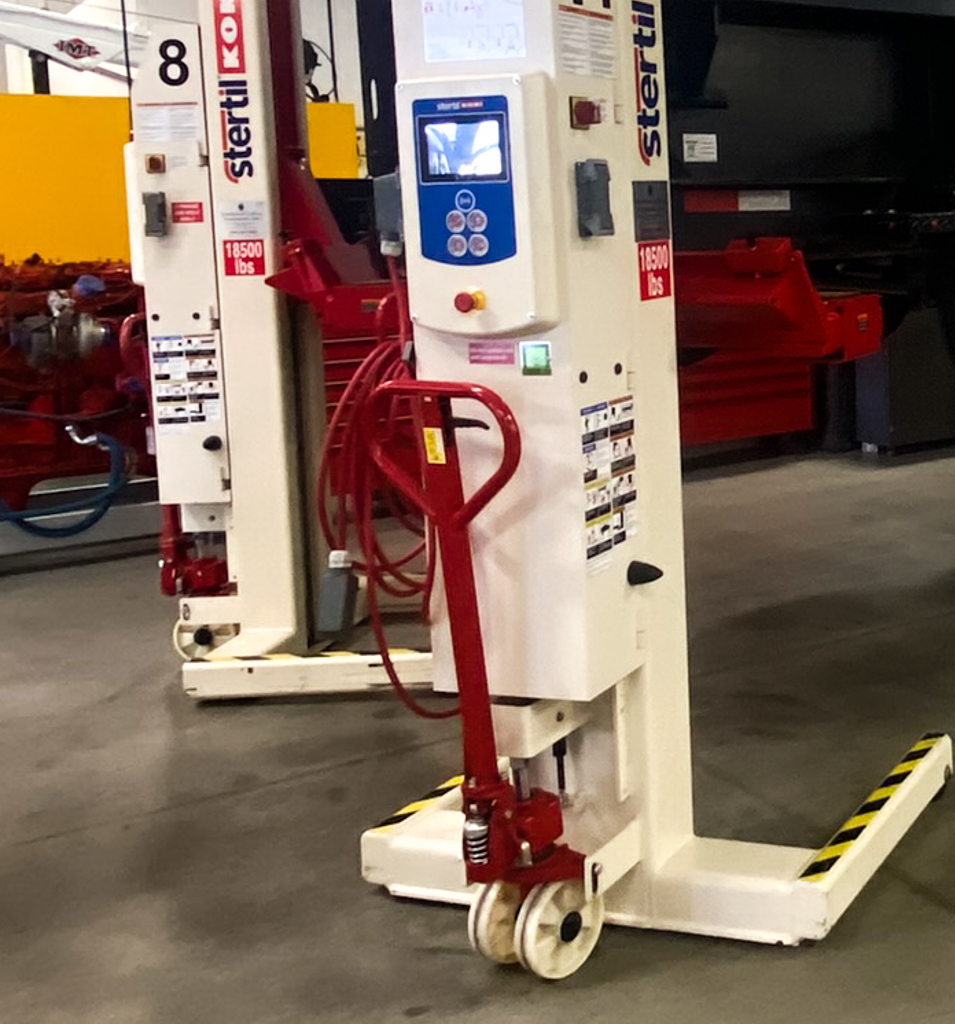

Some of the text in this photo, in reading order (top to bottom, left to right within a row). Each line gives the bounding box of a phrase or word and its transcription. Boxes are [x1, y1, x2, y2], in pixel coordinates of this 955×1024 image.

[158, 38, 190, 87] 8
[631, 0, 662, 160] stertil
[217, 79, 255, 181] stertil
[224, 241, 263, 259] 18500
[640, 244, 669, 273] 18500
[234, 258, 256, 275] lbs
[647, 271, 664, 297] lbs
